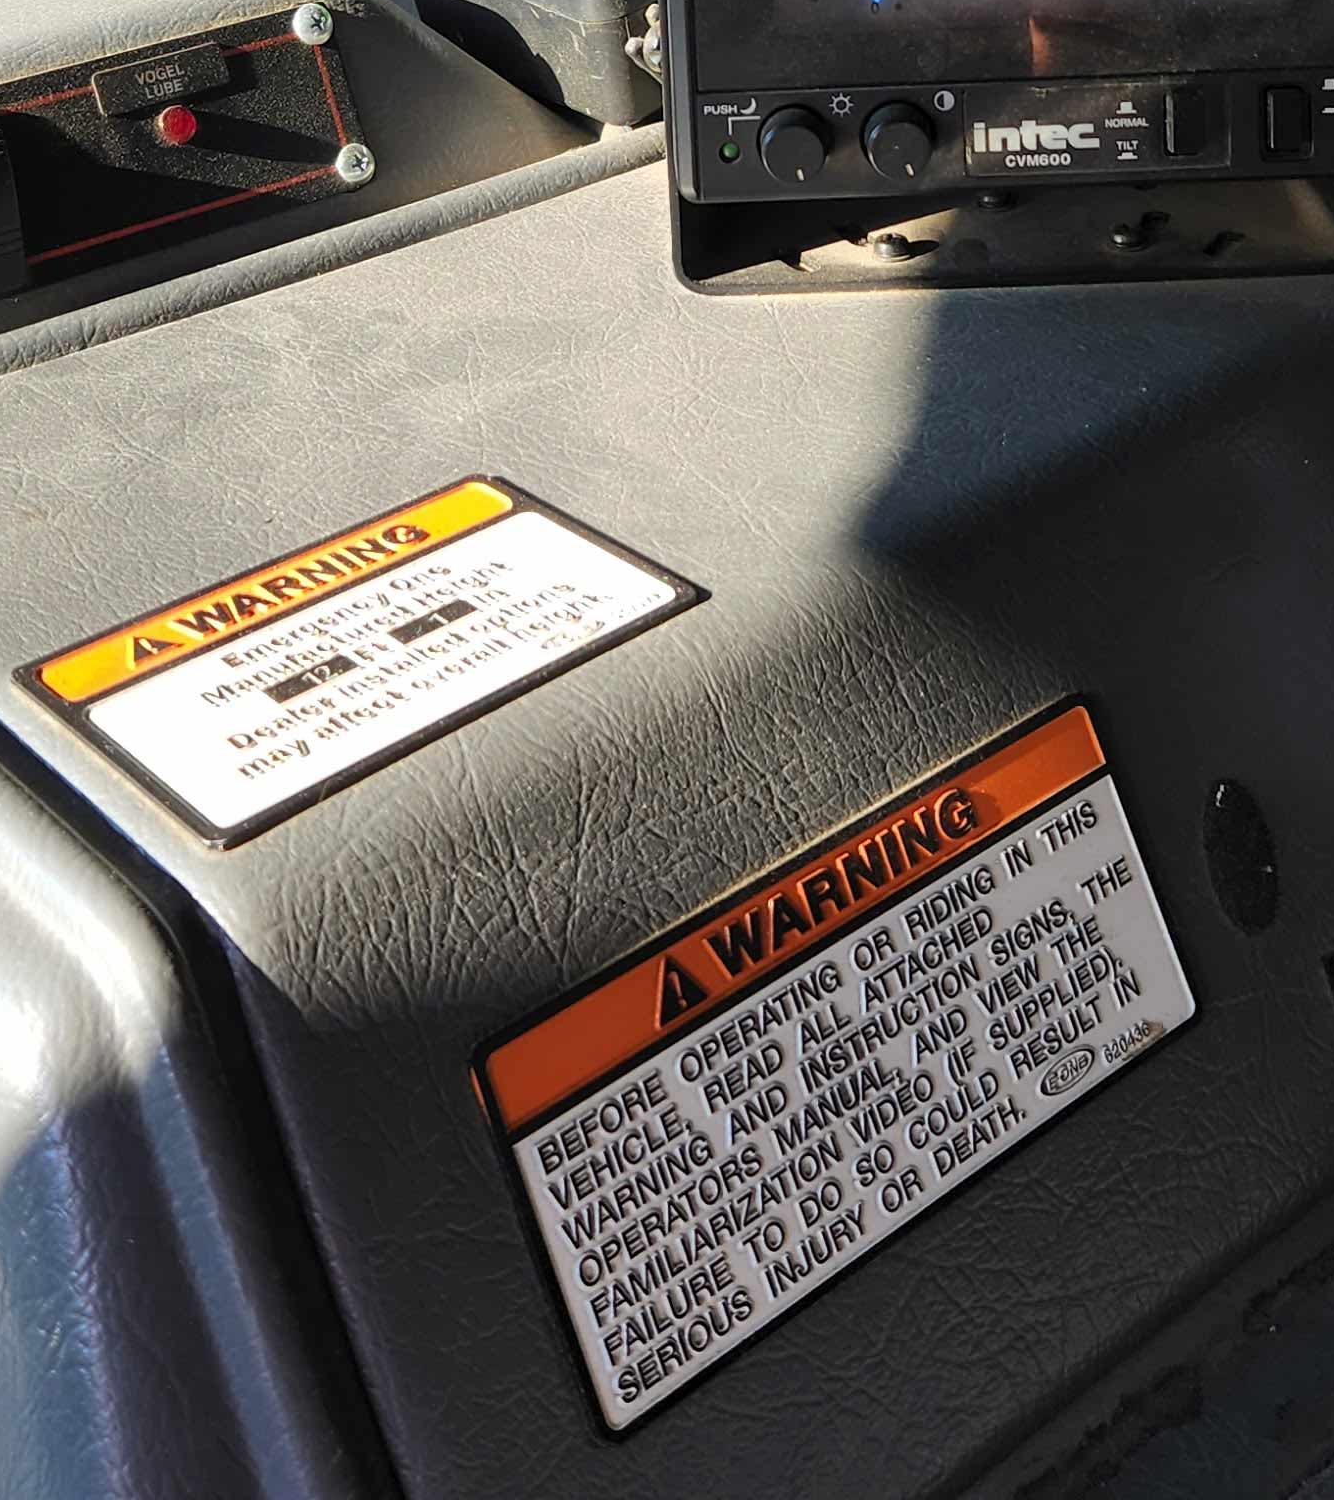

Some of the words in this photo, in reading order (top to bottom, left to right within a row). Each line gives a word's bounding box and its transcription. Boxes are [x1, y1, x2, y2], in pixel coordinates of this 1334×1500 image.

[135, 64, 185, 85] VOGEL
[145, 78, 185, 100] LUBE
[703, 104, 738, 115] PUSH
[973, 120, 1101, 153] intec
[1104, 117, 1150, 128] NORMAL
[1116, 140, 1139, 150] TILT
[1004, 153, 1072, 168] CVM600
[173, 522, 431, 639] WARNING
[198, 603, 417, 708] Manufactured
[410, 559, 517, 611] Height
[219, 589, 395, 672] Emergency
[386, 561, 454, 594] One
[225, 691, 341, 753] Dealer
[333, 629, 471, 700] installed
[464, 579, 581, 638] options
[234, 736, 316, 783] may
[308, 687, 412, 742] affect
[404, 636, 512, 692] overall
[704, 787, 980, 979] WARNING
[536, 1071, 667, 1174] BEFORE
[677, 961, 841, 1085] OPERATING
[851, 927, 896, 974] OR
[905, 864, 995, 940] RIDING
[1003, 841, 1032, 877] IN
[1040, 800, 1098, 854] THIS
[548, 1100, 692, 1215] VEHICLE,
[702, 1040, 784, 1113] READ
[794, 998, 850, 1053] ALL
[859, 905, 995, 1012] ATTACHED
[561, 1131, 713, 1252] WARNING
[723, 1081, 789, 1145] AND
[800, 955, 981, 1094] INSTRUCTION
[990, 894, 1075, 970] SIGNS,
[1082, 856, 1132, 906] THE
[1101, 1018, 1152, 1067] 620436
[575, 1142, 764, 1290] OPERATORS
[774, 1050, 902, 1158] MANUAL,
[910, 1005, 969, 1063] AND
[979, 955, 1042, 1016] VIEW
[1052, 915, 1102, 967] THE
[588, 1134, 841, 1328] FAMILIARIZATION
[853, 1070, 935, 1145] VIDEO
[945, 1040, 981, 1084] (IF
[987, 942, 1124, 1055] SUPPLIED).
[602, 1253, 734, 1366] FAILURE
[746, 1217, 787, 1265] TO
[800, 1177, 844, 1227] DO
[854, 1141, 896, 1188] SO
[906, 1068, 1000, 1152] COULD
[1010, 995, 1105, 1079] RESULT
[1114, 970, 1140, 1006] IN
[614, 1286, 754, 1406] SERIOUS
[765, 1204, 869, 1298] INJURY
[880, 1166, 923, 1215] OR
[932, 1092, 1028, 1180] DEATH.
